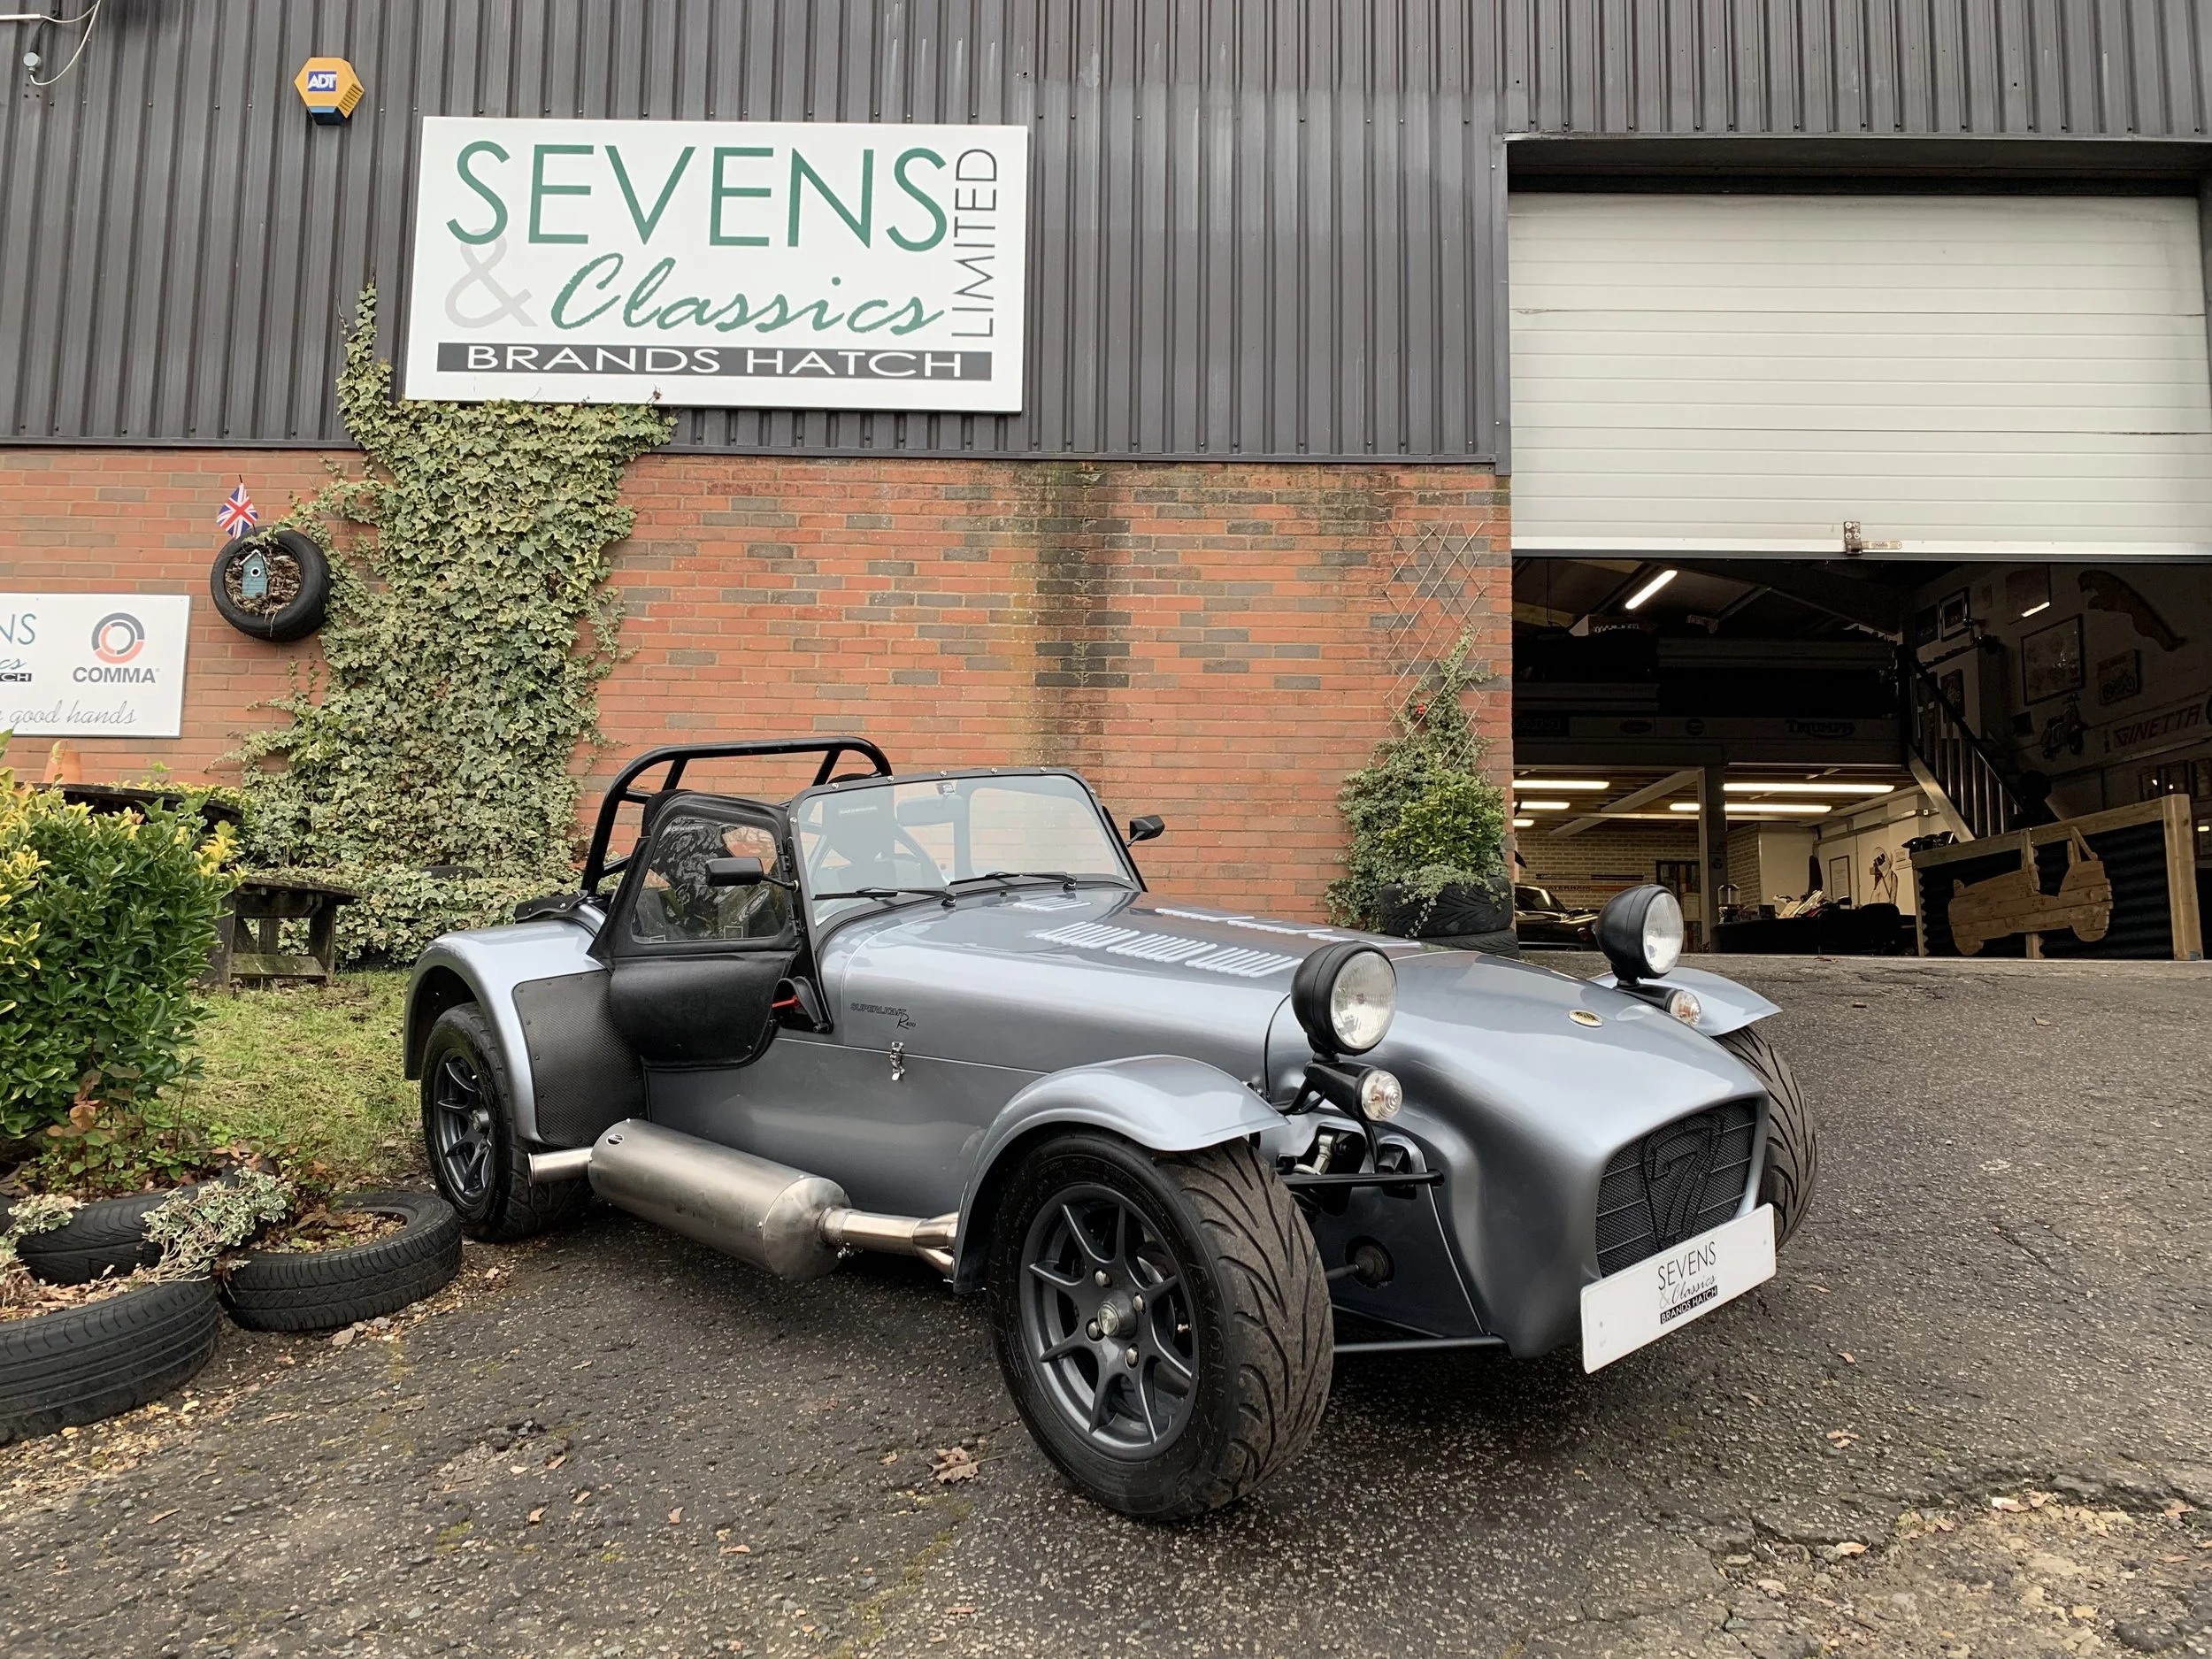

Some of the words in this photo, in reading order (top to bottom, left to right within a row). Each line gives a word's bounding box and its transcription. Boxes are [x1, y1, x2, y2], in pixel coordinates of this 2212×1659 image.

[308, 73, 337, 88] ADT
[446, 140, 948, 252] SEVENS
[951, 148, 998, 339] LIMITED
[444, 227, 538, 328] &
[550, 252, 945, 337] Classics
[466, 345, 721, 374] BRANDS
[746, 349, 962, 379] HATCH
[73, 666, 156, 684] COMMA
[10, 699, 63, 730] good
[66, 700, 137, 724] hands
[1658, 1240, 1717, 1291] SEVENS
[1660, 1300, 1692, 1324] BRANDS
[1692, 1286, 1717, 1307] HATCH
[1671, 1274, 1716, 1304] Classics
